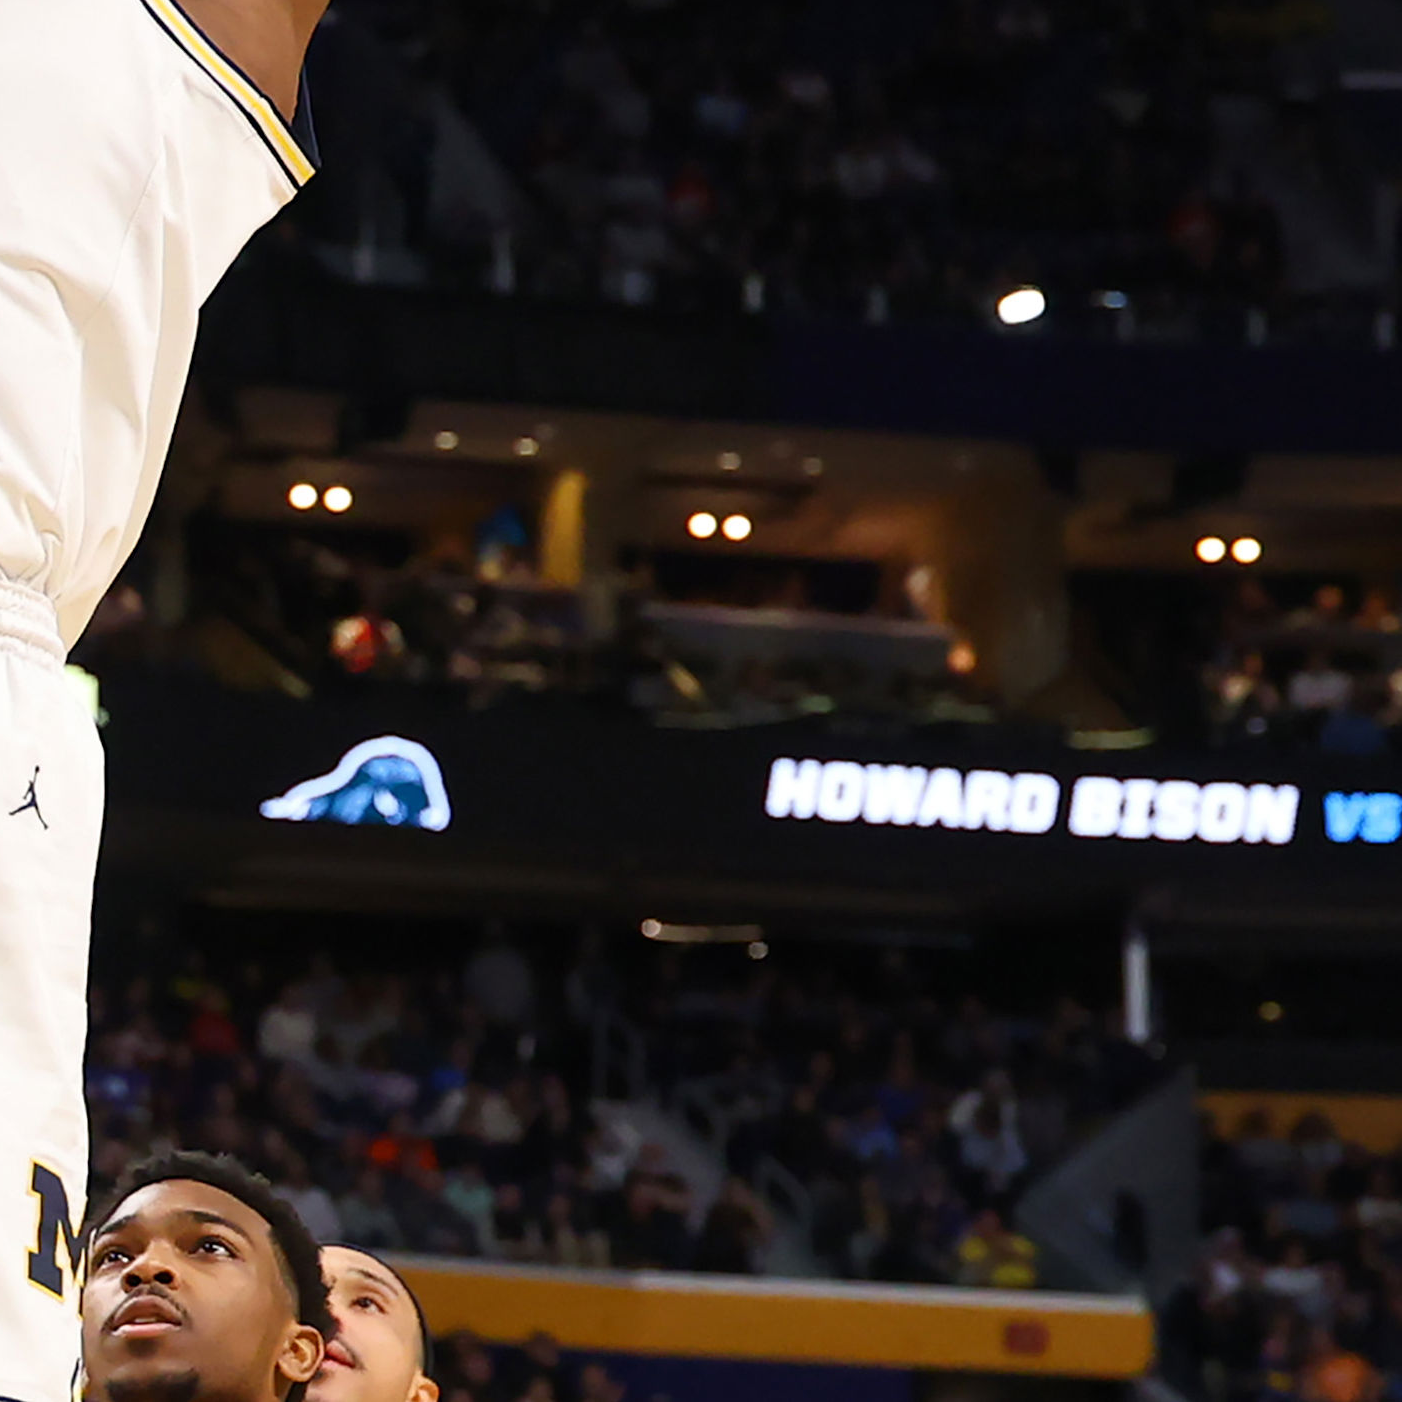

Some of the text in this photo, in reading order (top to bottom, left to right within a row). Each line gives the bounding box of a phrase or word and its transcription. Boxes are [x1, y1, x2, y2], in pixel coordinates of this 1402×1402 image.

[764, 757, 1402, 845] HOWARD BISON VS
